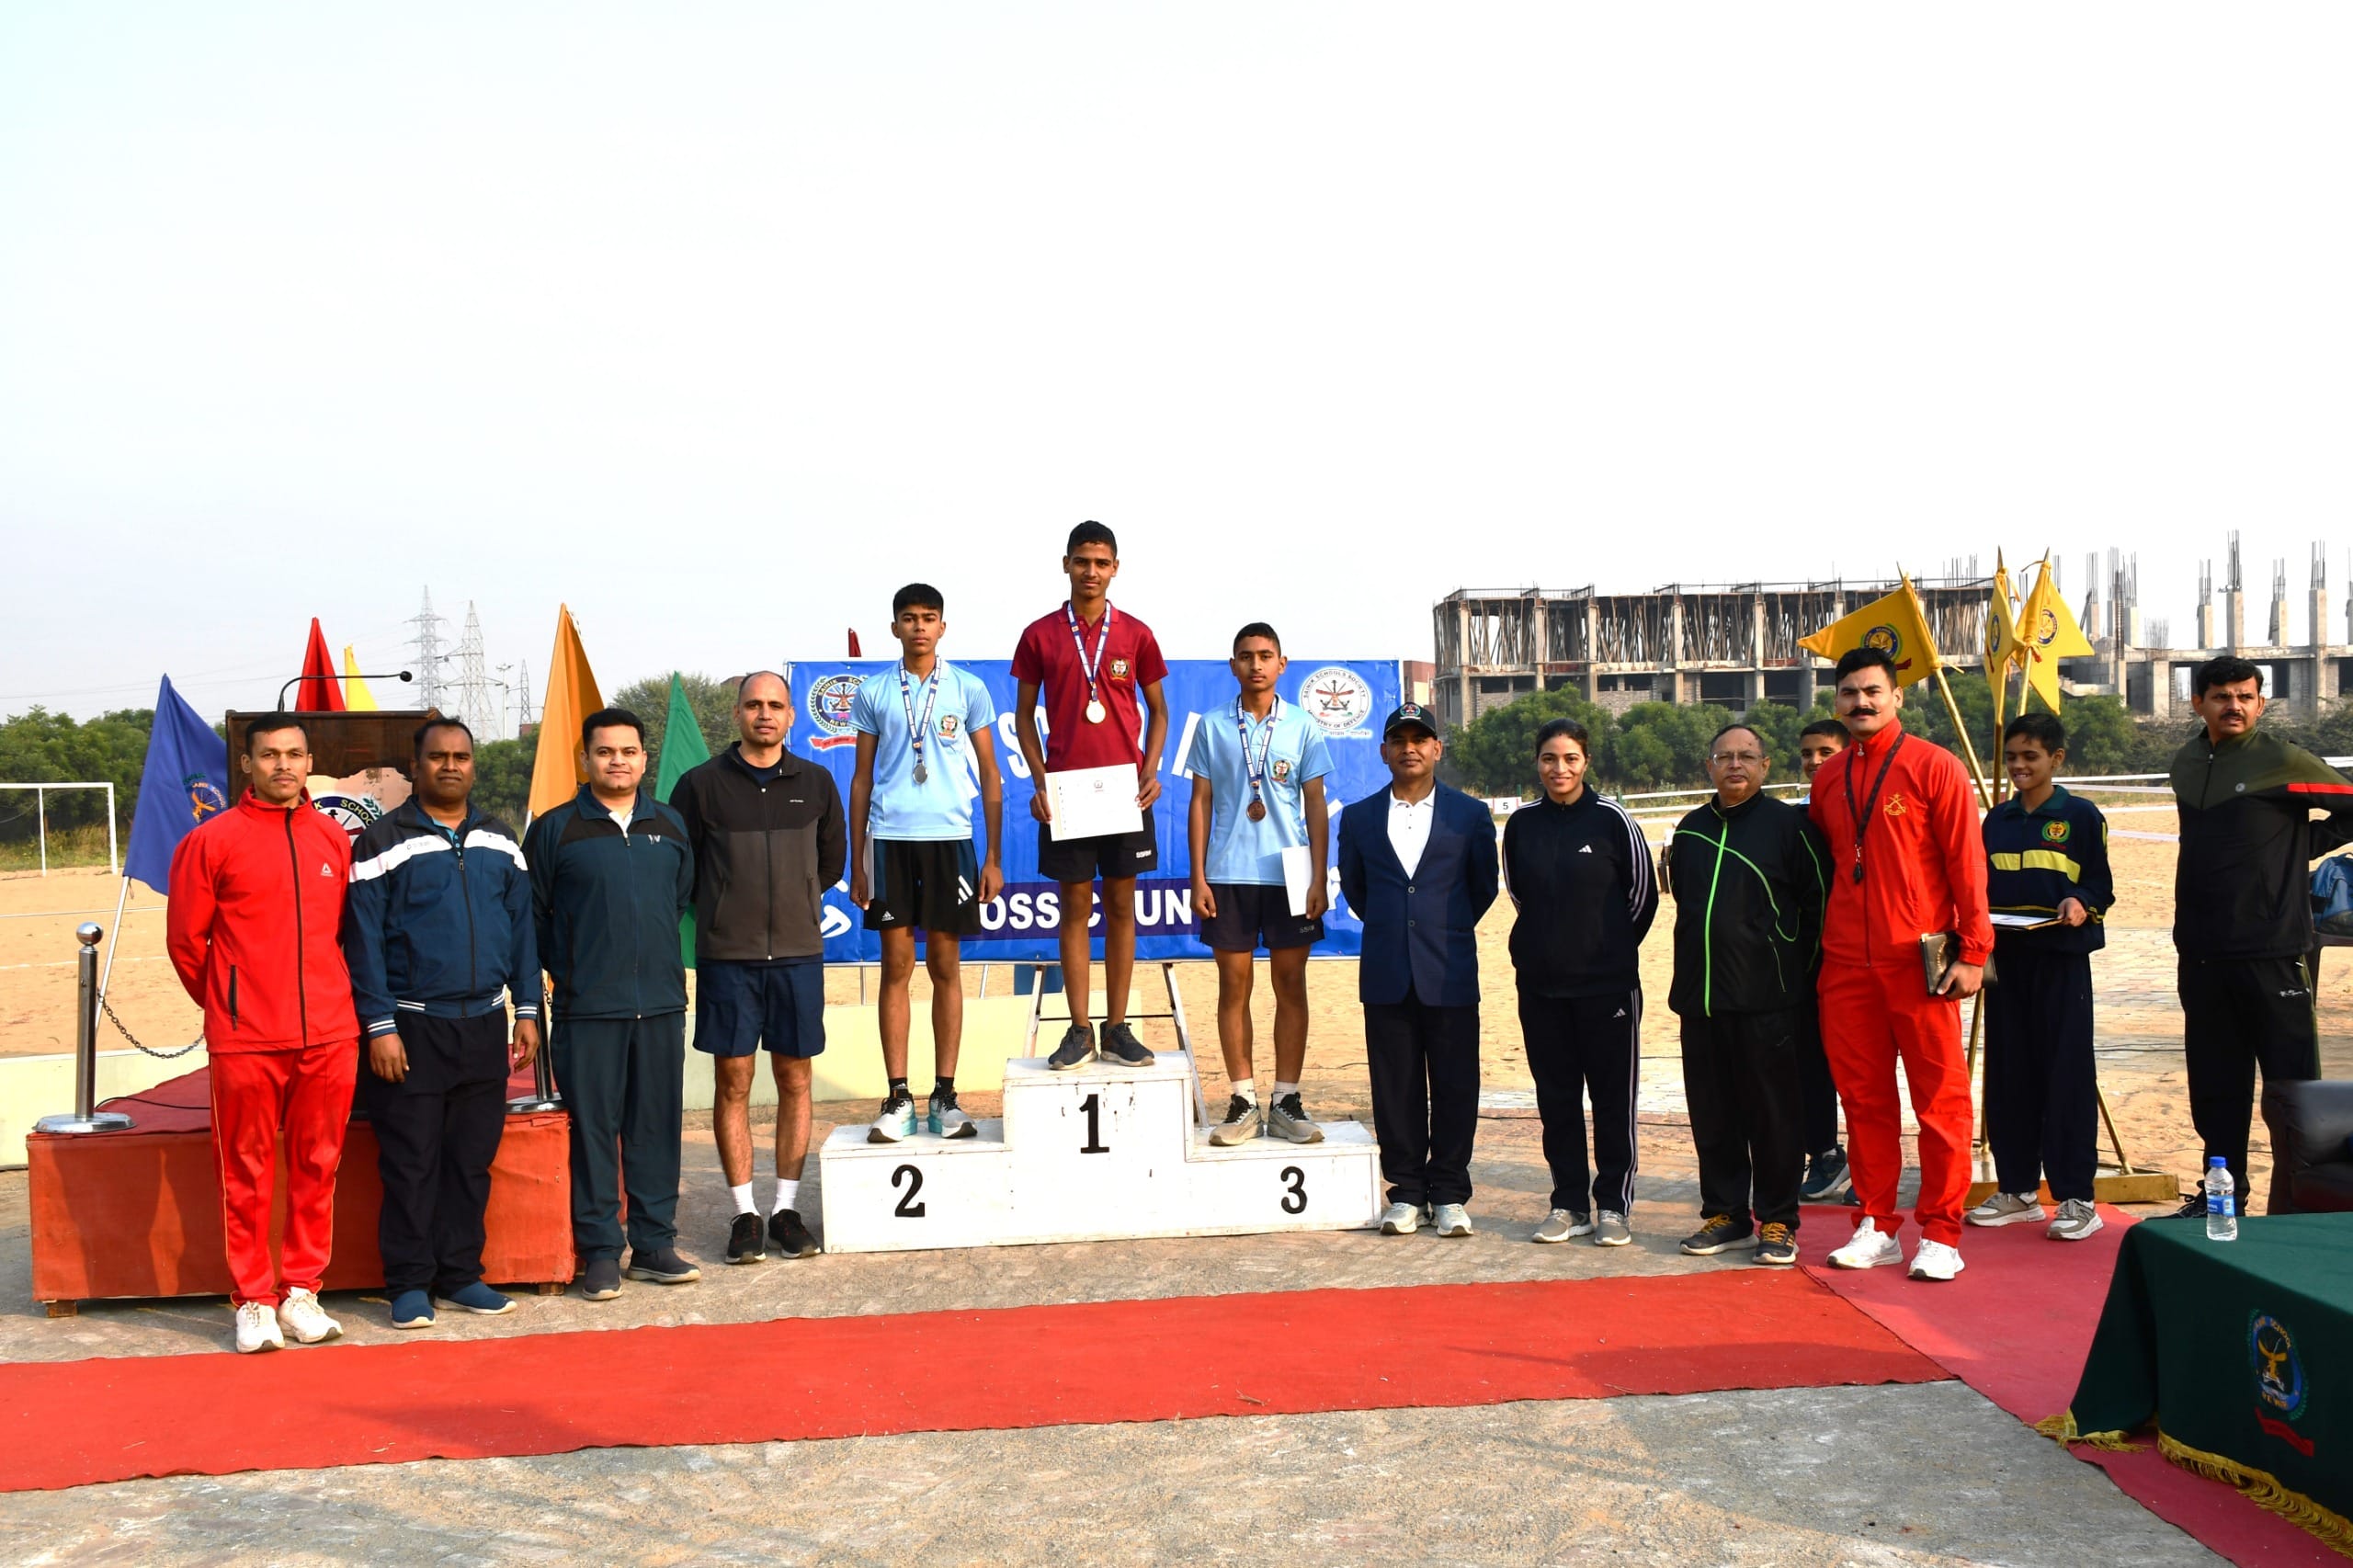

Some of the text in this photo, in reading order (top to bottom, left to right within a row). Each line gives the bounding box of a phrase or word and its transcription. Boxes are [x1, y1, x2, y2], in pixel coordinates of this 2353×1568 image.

[818, 679, 837, 696] SAINIK
[340, 799, 374, 826] SCHOO
[1502, 801, 1509, 810] 5
[1079, 1094, 1109, 1153] 1
[892, 1165, 926, 1218] 2
[1280, 1166, 1308, 1214] 3
